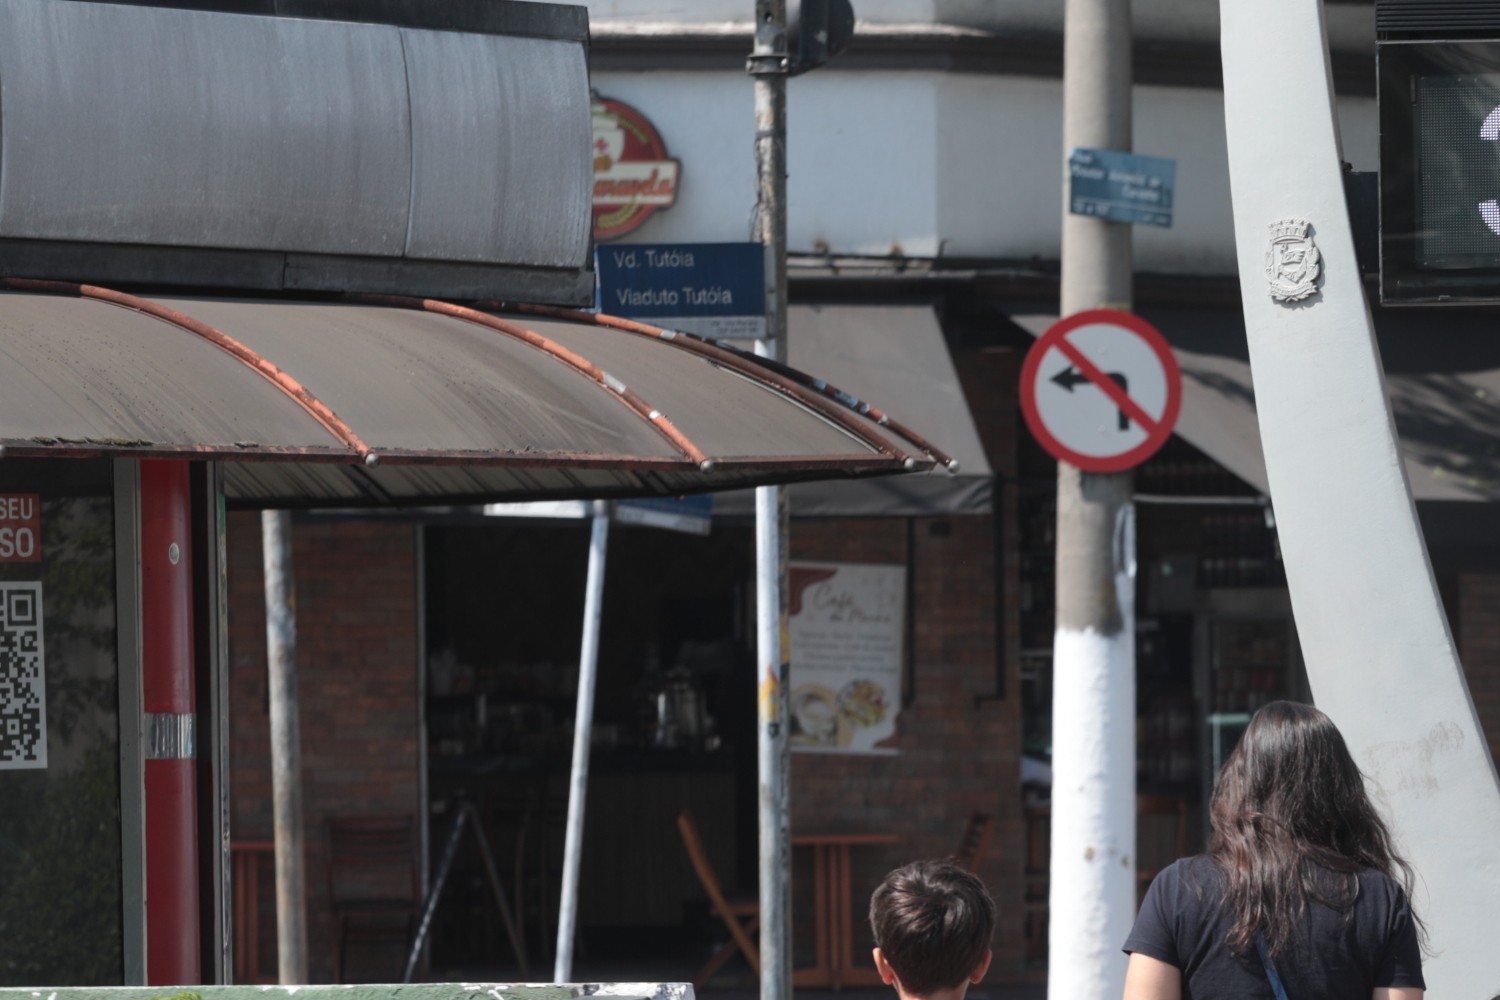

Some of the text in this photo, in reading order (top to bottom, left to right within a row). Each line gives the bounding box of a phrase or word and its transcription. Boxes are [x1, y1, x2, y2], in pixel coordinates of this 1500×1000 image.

[613, 249, 694, 268] Vd. Tutóia
[616, 285, 732, 306] Viaduto Tutóia
[0, 498, 32, 519] SEU
[0, 527, 33, 557] SO
